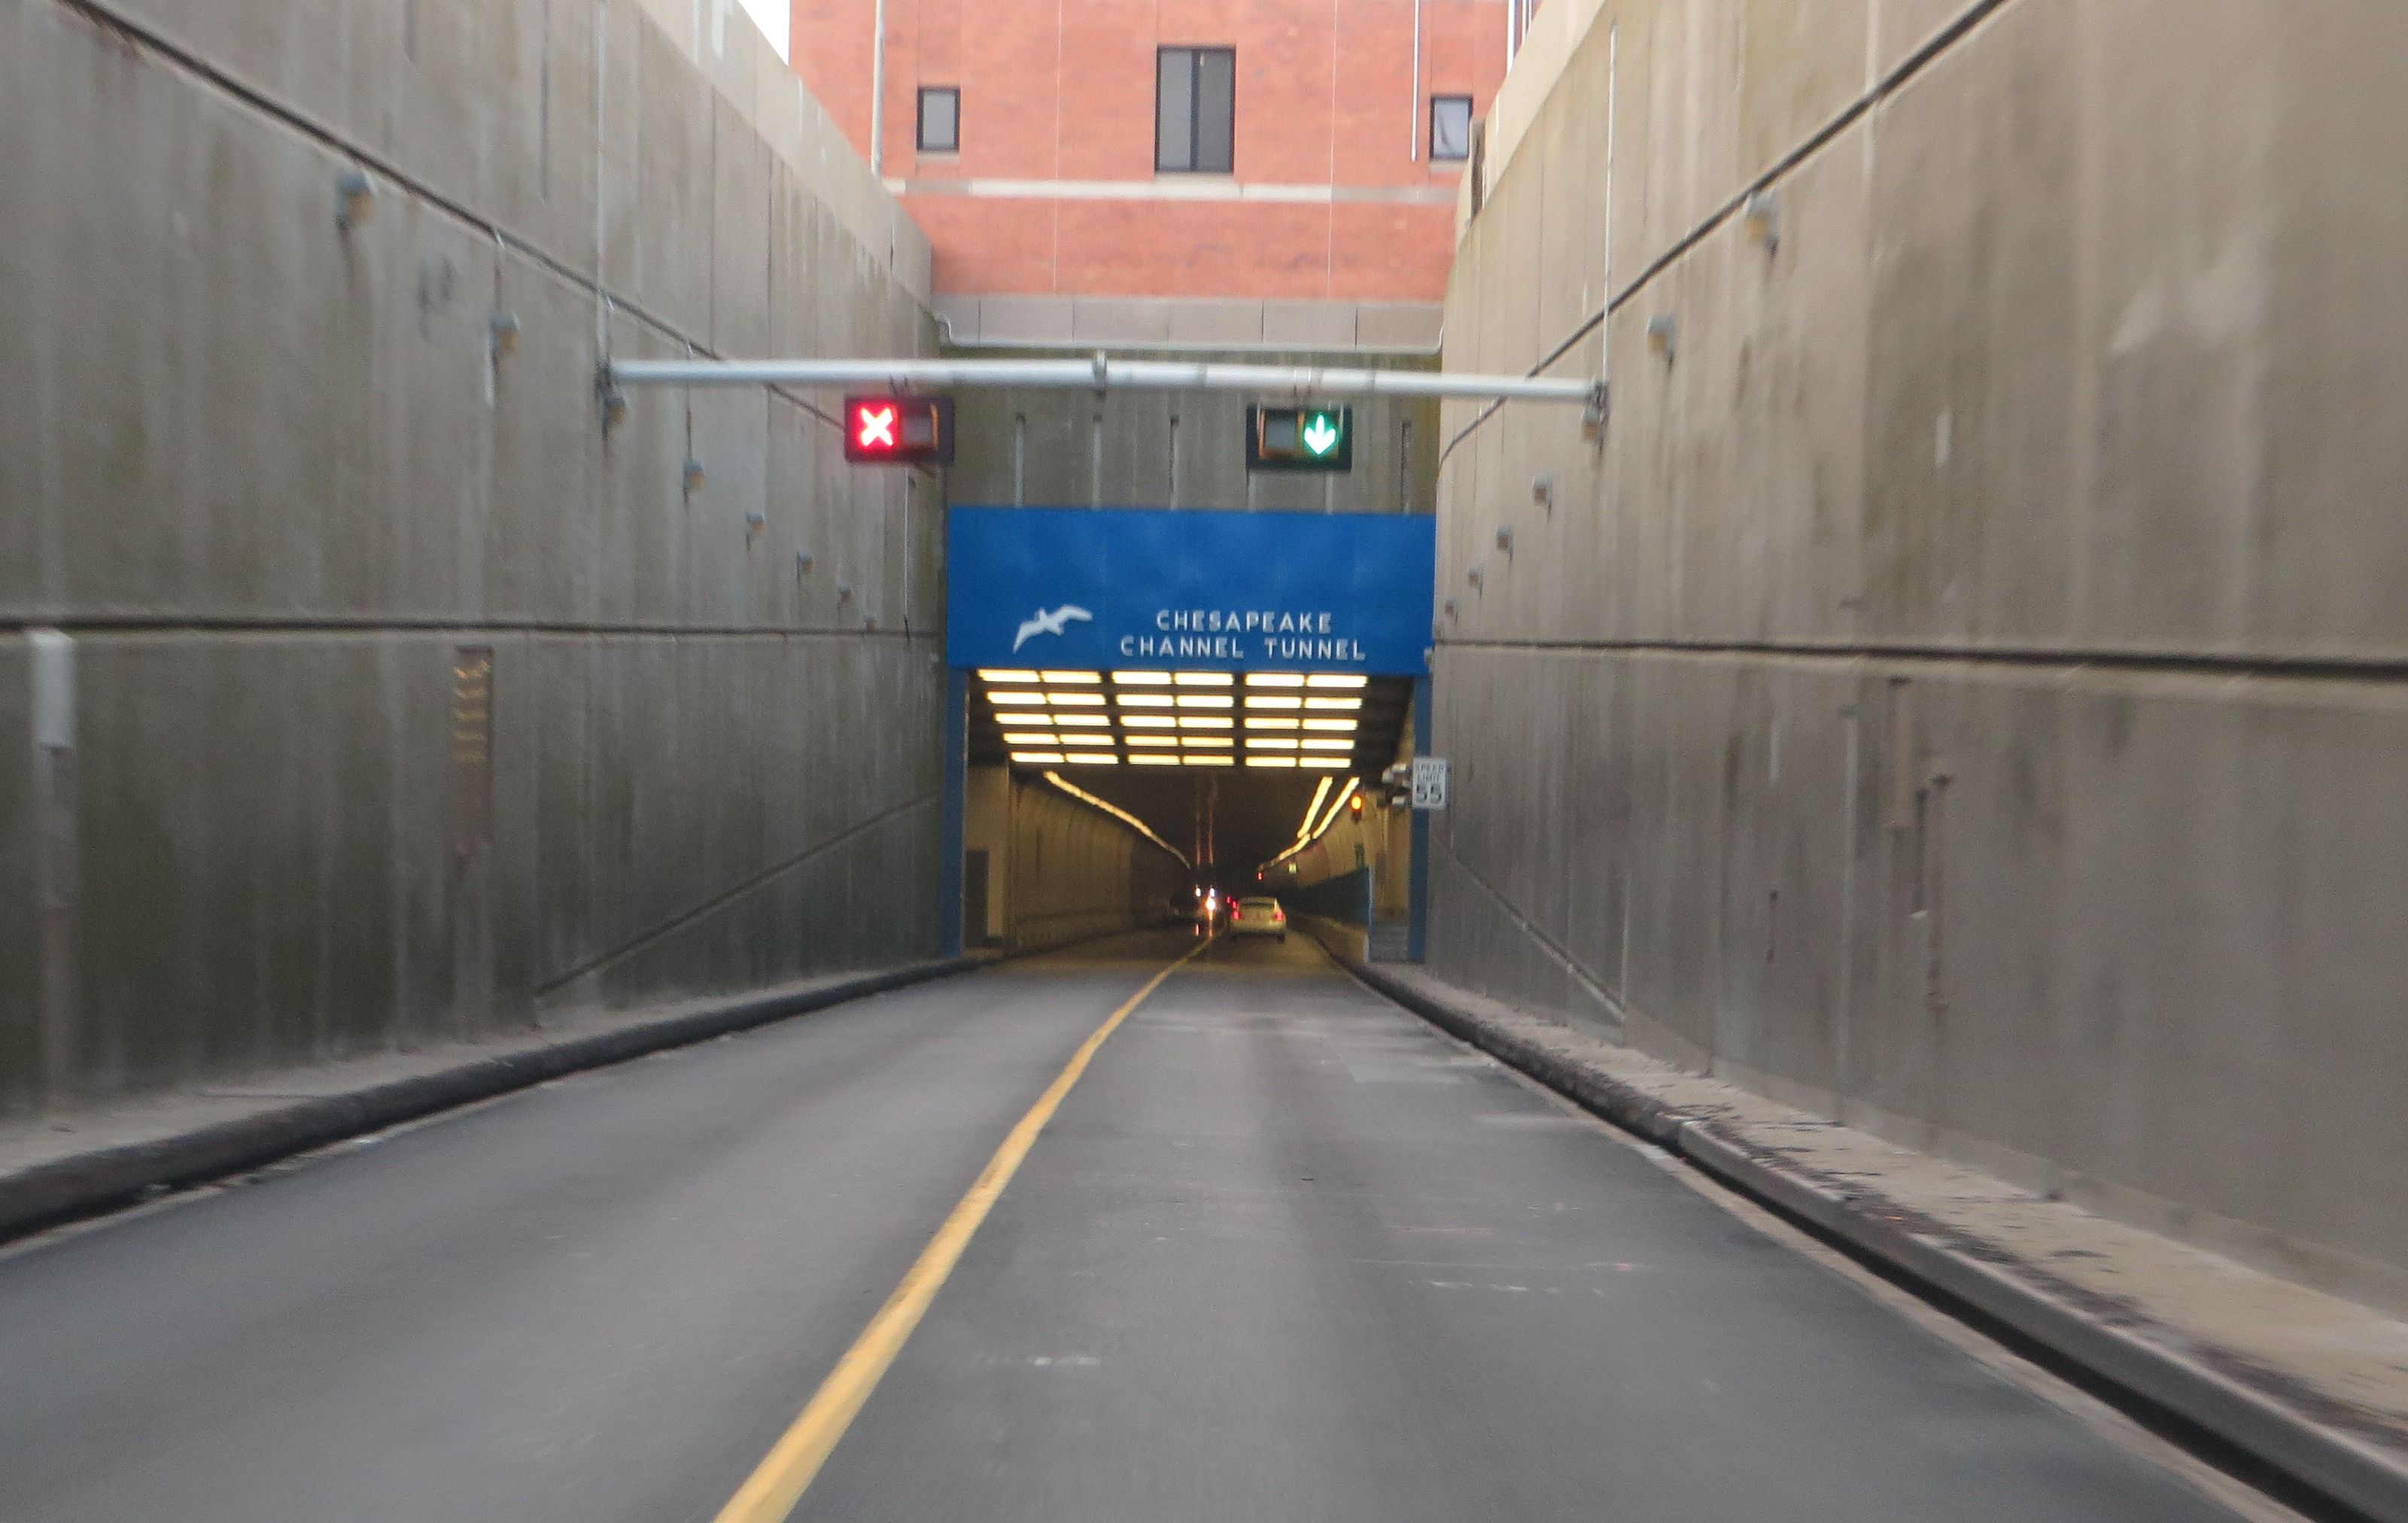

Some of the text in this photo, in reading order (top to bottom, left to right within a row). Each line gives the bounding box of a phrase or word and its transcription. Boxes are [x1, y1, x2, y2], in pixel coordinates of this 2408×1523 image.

[1156, 610, 1332, 634] CHESAPEAKE
[1120, 636, 1366, 661] CHANNEL TUNNEL
[1415, 784, 1441, 804] 55
